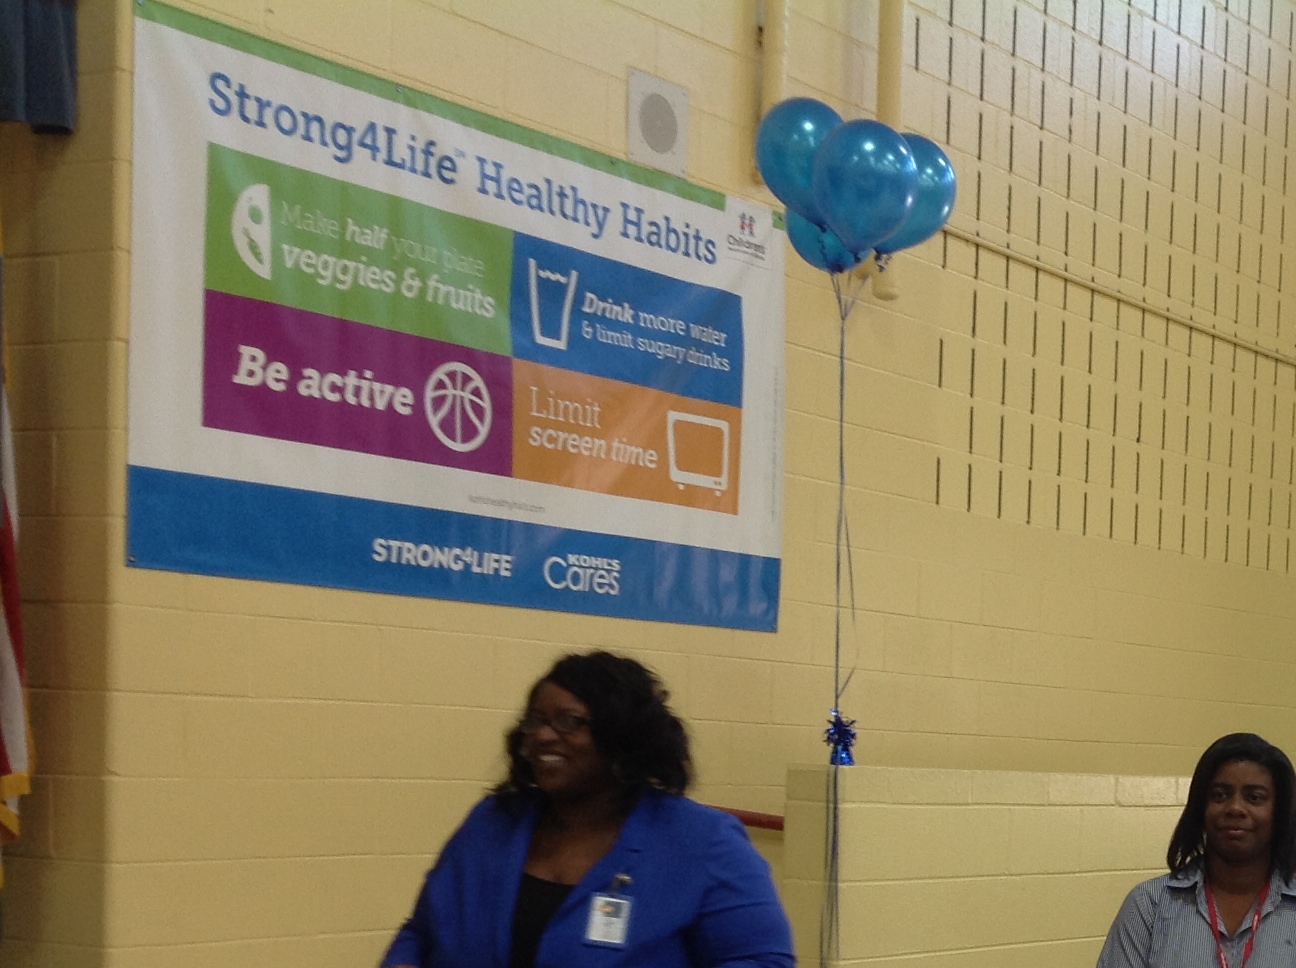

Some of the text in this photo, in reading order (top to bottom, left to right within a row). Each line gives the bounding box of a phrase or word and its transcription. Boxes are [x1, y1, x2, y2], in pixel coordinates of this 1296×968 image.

[280, 201, 339, 239] Make
[345, 218, 389, 250] half
[475, 155, 611, 240] Healthy
[620, 201, 717, 265] Habits
[281, 243, 496, 318] veggies & fruits
[581, 291, 728, 347] Drink more water
[581, 320, 731, 371] & limit sugary drinks
[232, 344, 415, 415] Be active
[529, 386, 602, 428] Limit
[528, 426, 658, 468] screen time
[543, 556, 621, 595] Cares
